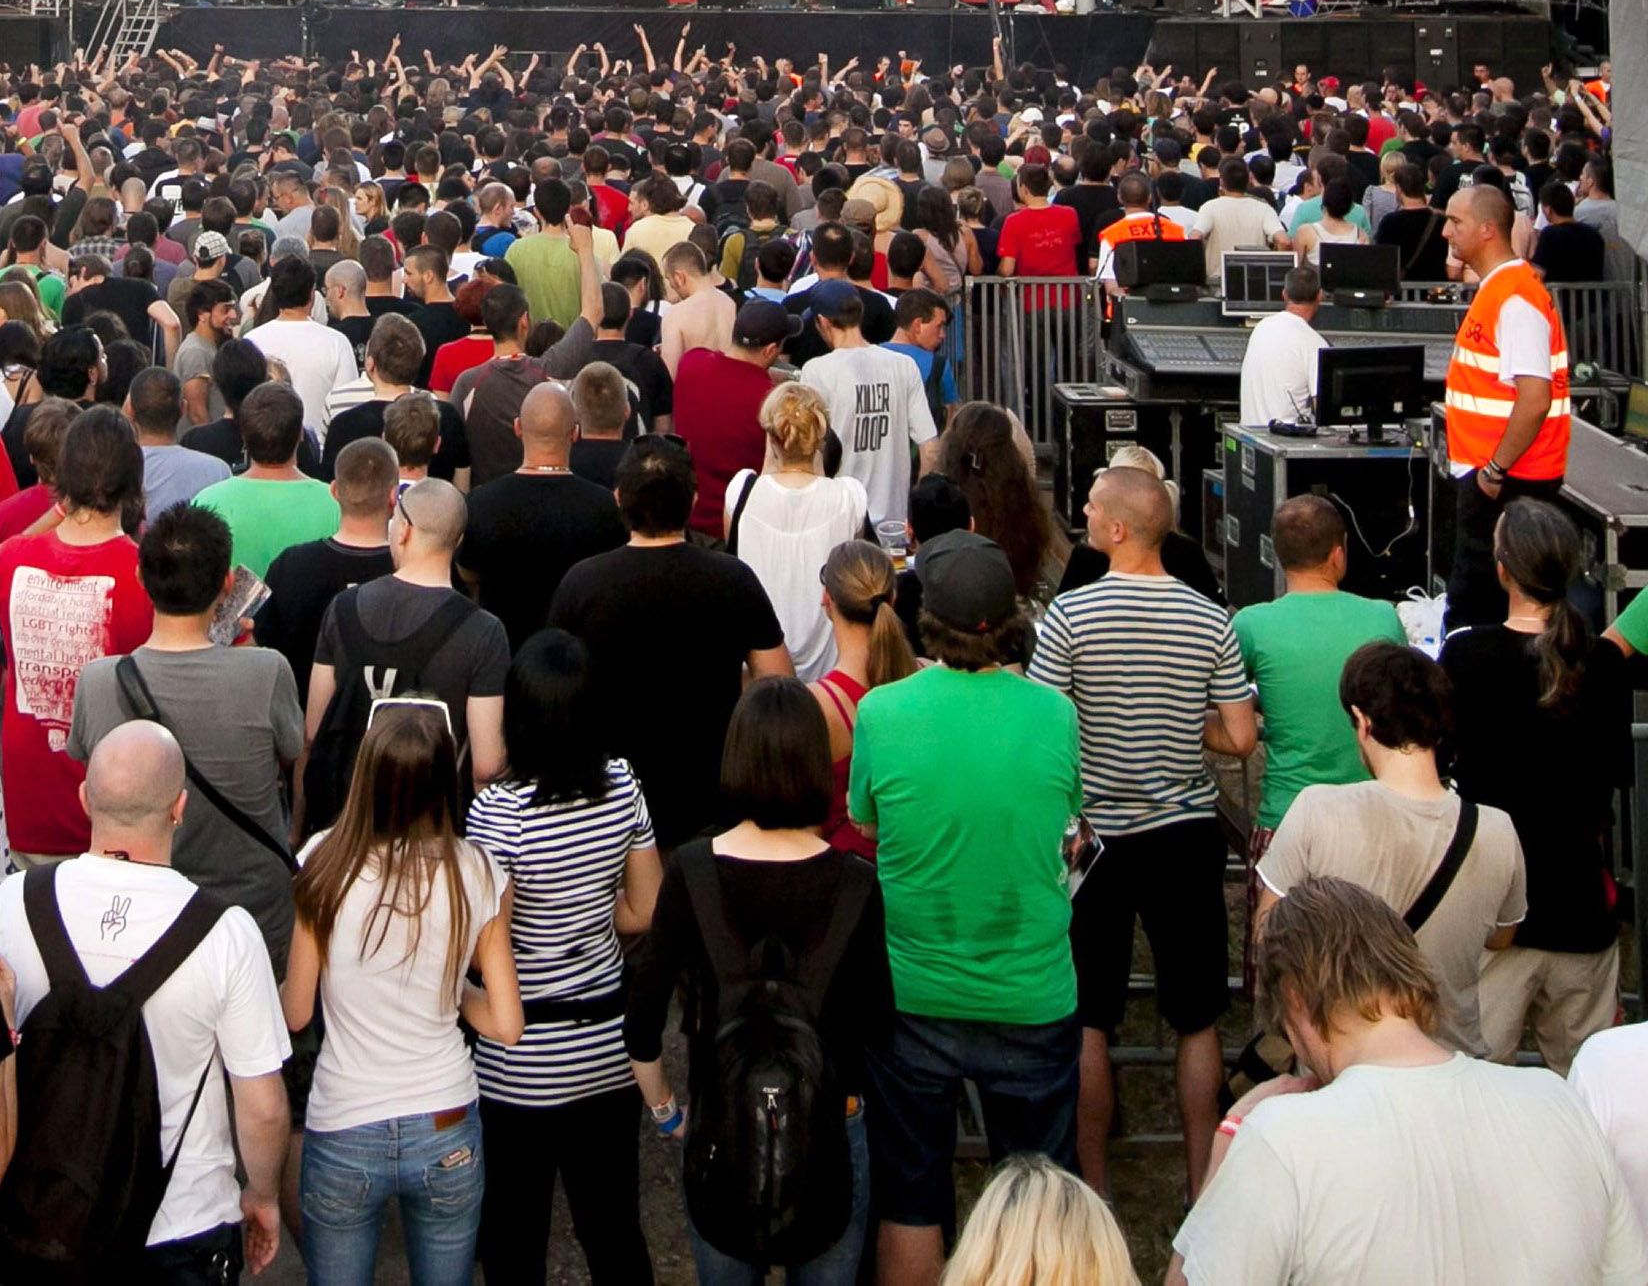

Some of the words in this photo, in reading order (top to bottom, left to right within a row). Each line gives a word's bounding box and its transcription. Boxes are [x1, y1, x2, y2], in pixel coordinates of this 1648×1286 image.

[855, 383, 890, 414] KILLER
[853, 415, 889, 453] LOOP
[22, 617, 53, 631] LGBT
[16, 647, 58, 660] mental
[18, 660, 82, 679] transpo
